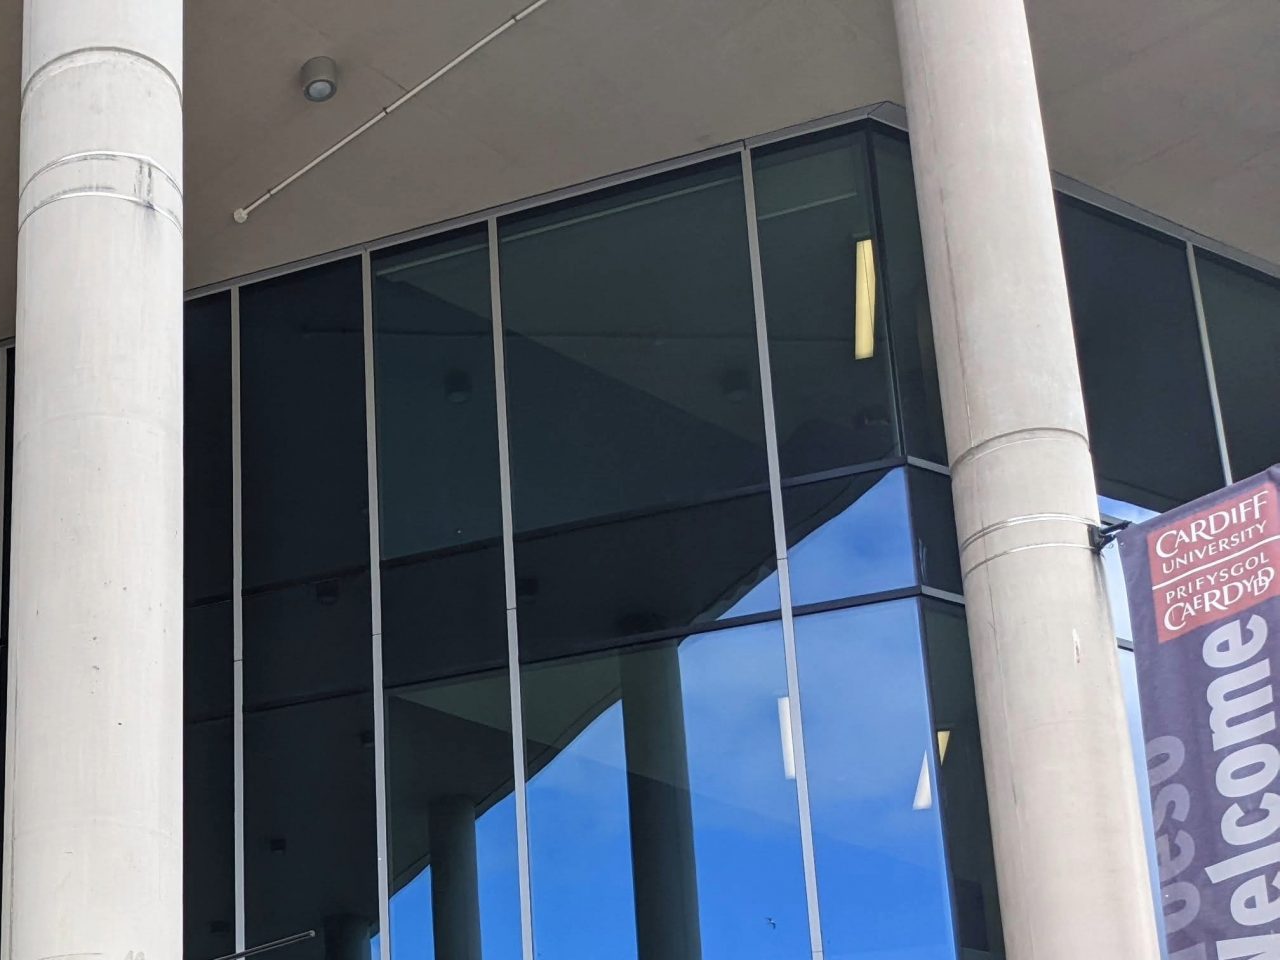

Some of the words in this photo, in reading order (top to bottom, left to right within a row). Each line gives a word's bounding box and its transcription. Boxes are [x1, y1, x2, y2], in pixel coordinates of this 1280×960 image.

[1156, 490, 1269, 558] CARDIFF
[1162, 520, 1266, 574] UNIVERSITY
[1166, 552, 1269, 604] PRIFYSGOL
